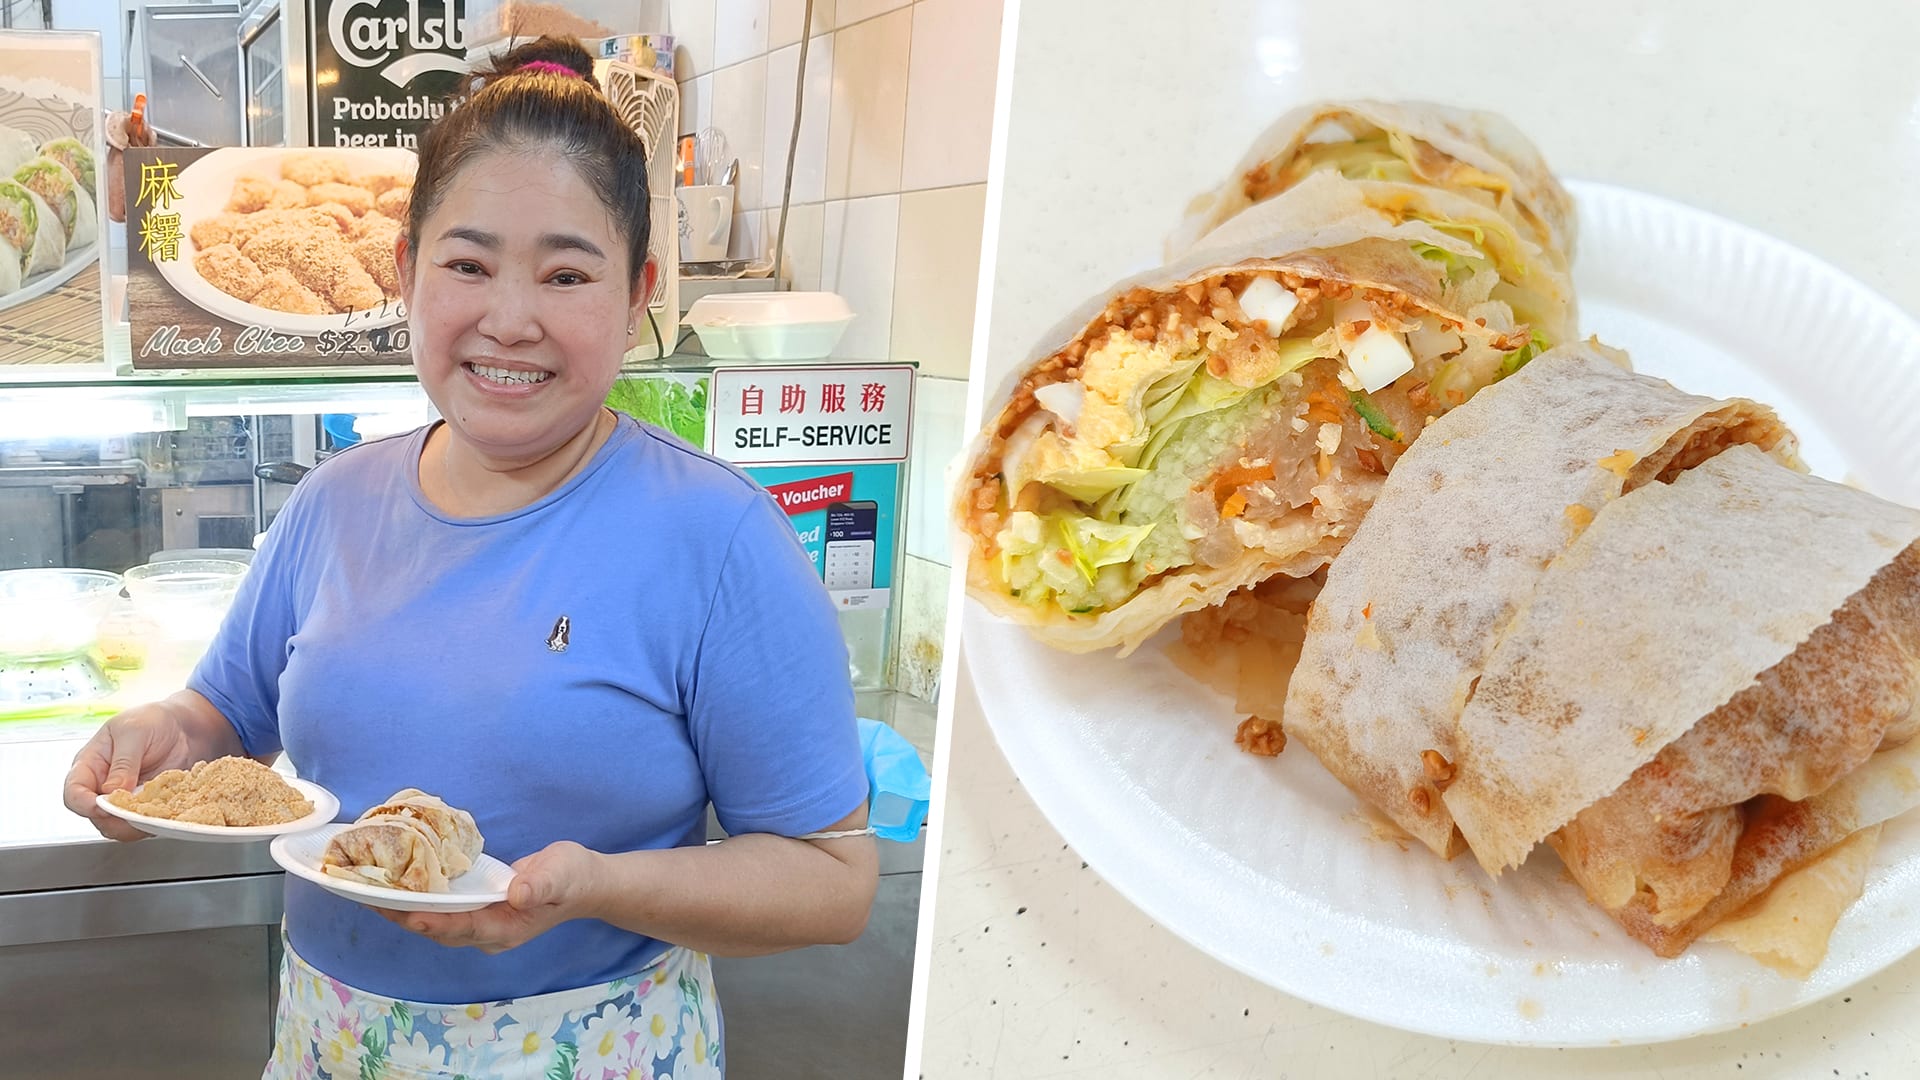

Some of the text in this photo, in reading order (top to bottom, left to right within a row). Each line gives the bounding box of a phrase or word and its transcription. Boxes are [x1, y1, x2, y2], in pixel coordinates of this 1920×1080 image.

[333, 127, 418, 149] beer in
[234, 324, 305, 355] Chee
[741, 383, 887, 416] 自助服務
[734, 424, 892, 449] SELF-SERVICE
[782, 484, 845, 507] Voucher
